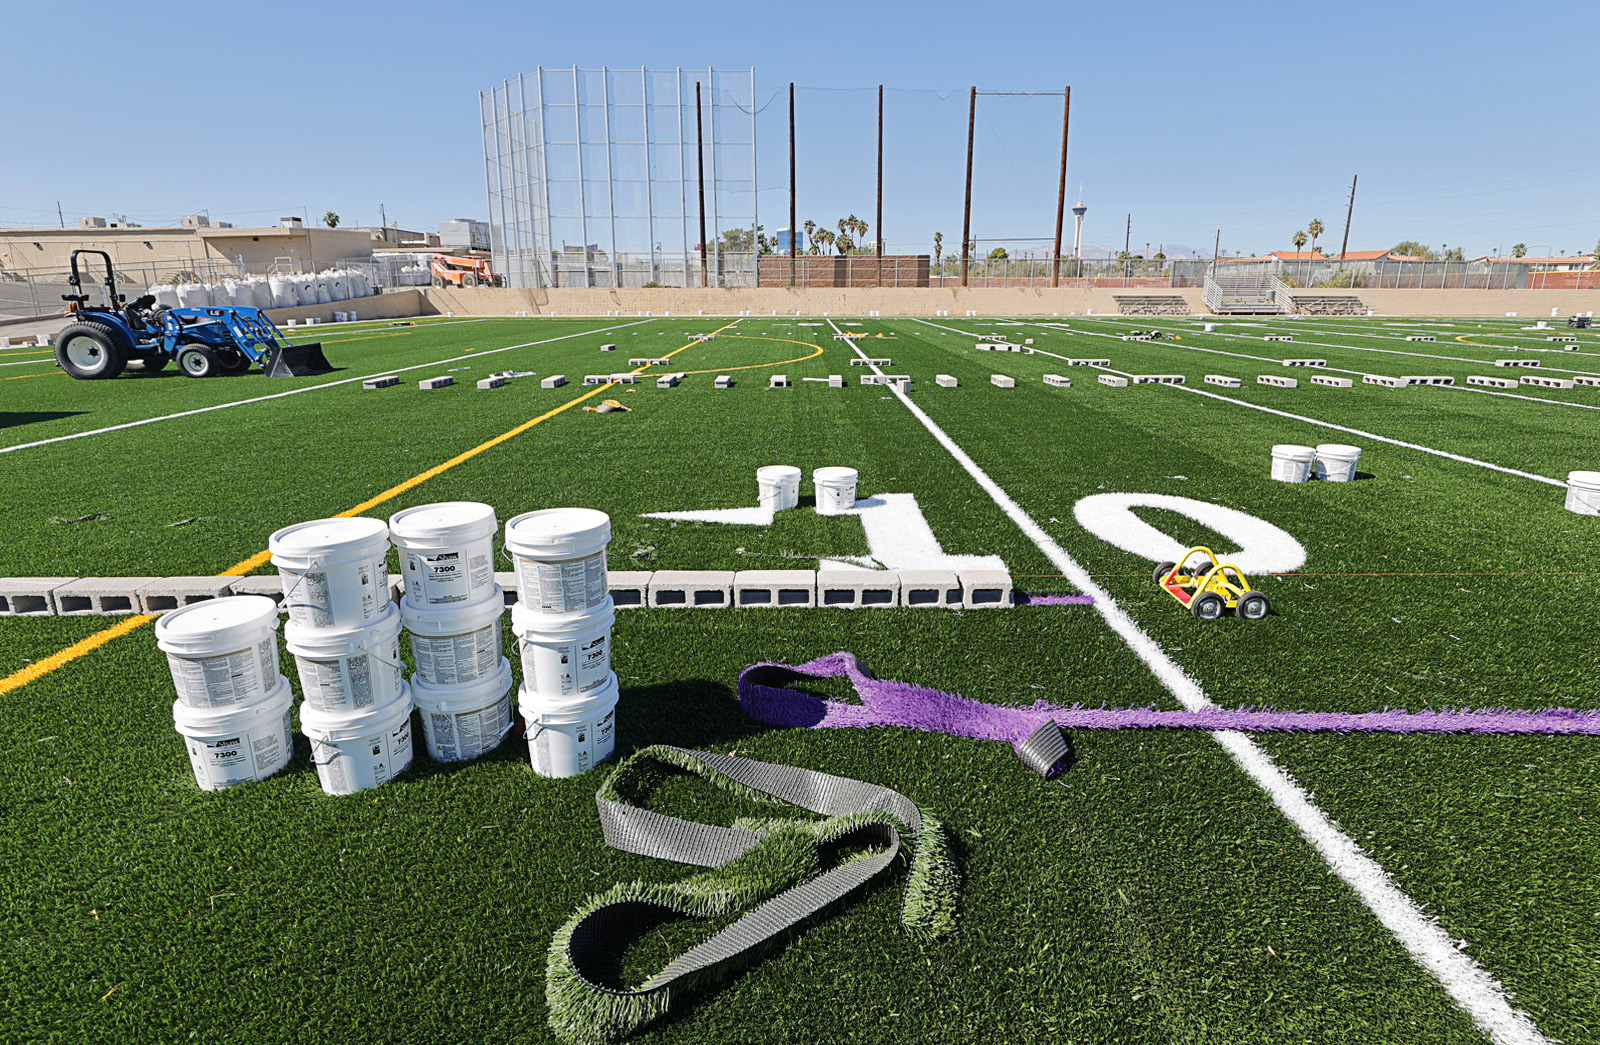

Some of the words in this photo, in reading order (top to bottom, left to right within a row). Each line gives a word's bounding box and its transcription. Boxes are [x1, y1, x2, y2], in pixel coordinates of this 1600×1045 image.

[433, 565, 456, 573] 7300
[586, 649, 604, 661] 7300
[214, 750, 238, 759] 7300
